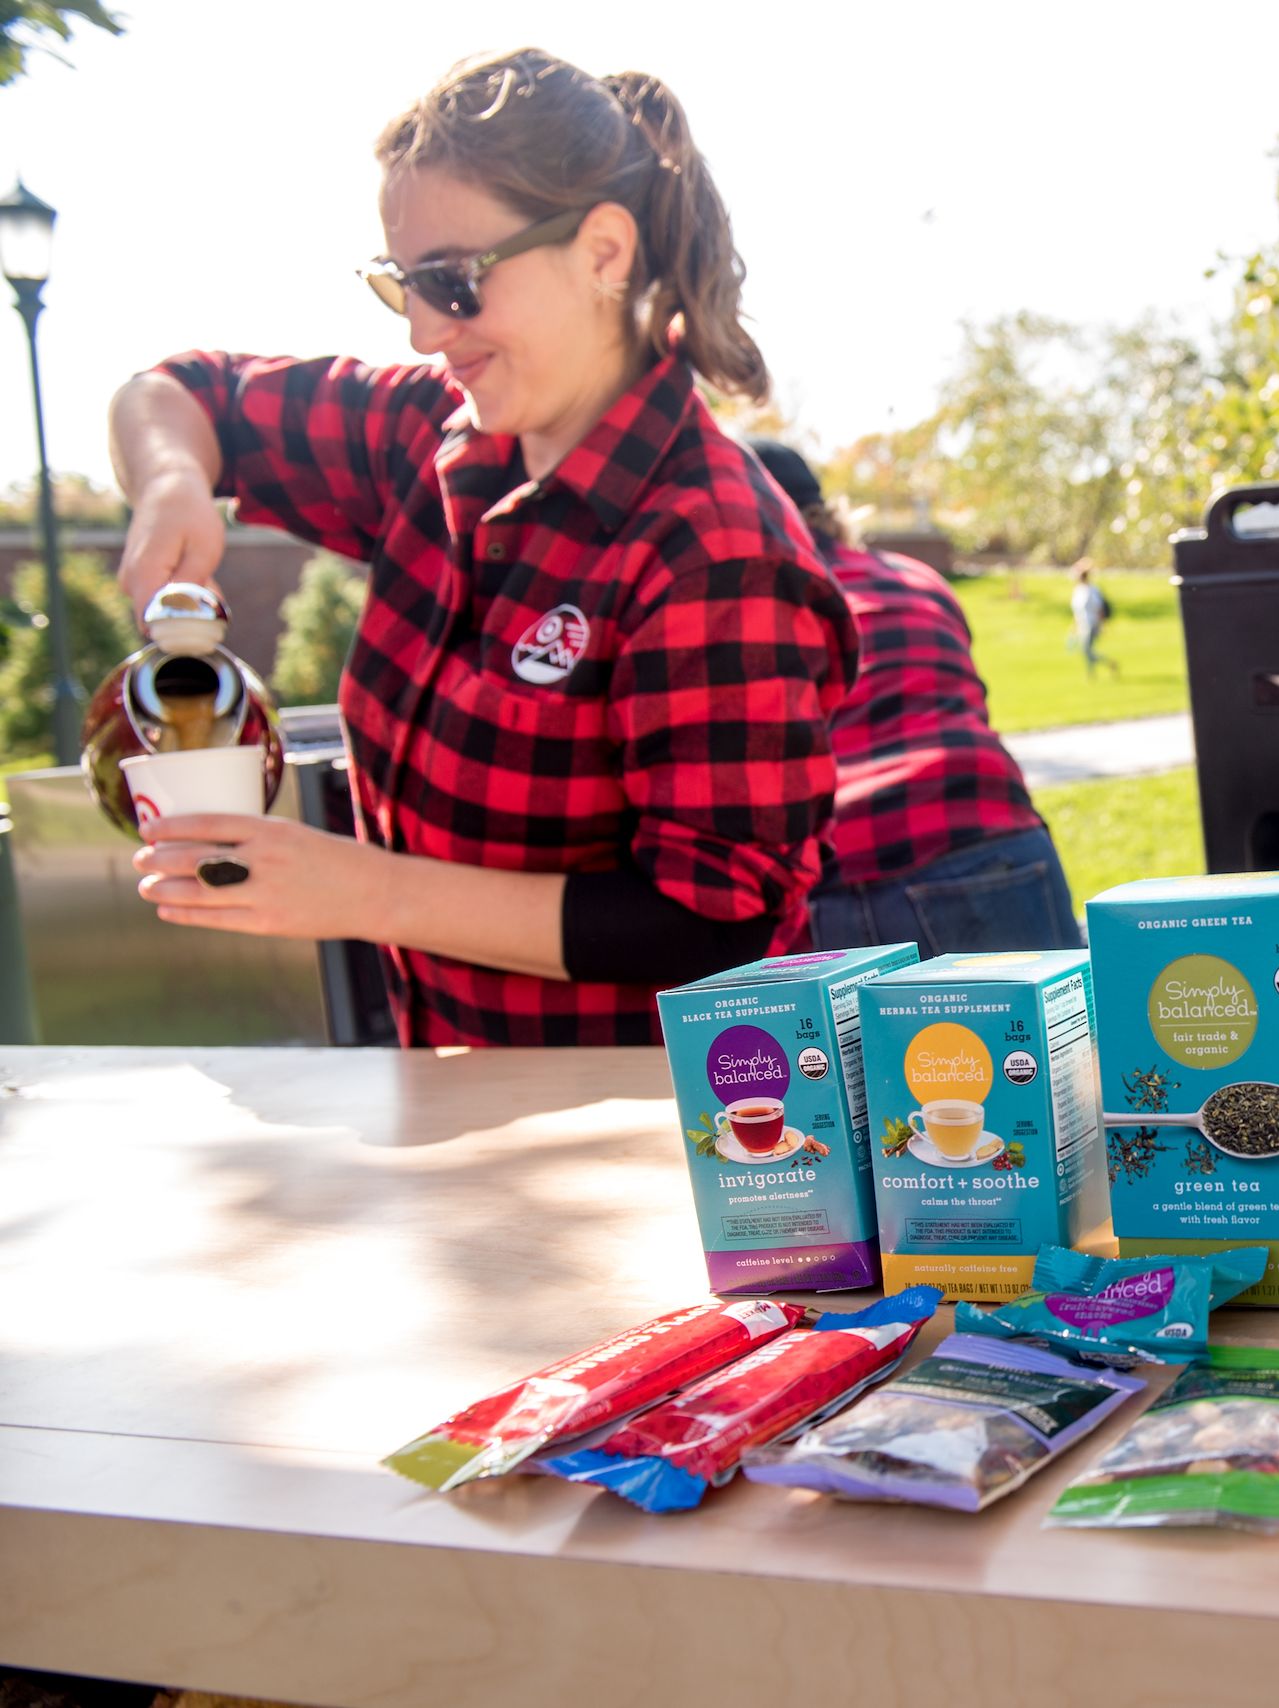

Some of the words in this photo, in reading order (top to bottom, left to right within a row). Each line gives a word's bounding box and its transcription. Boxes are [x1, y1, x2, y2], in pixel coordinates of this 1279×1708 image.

[1138, 918, 1188, 930] ORGANIC
[1191, 917, 1228, 928] GREEN
[1232, 916, 1253, 926] TEA
[1044, 981, 1071, 1004] Supplement
[1069, 978, 1083, 992] Facts
[1165, 976, 1245, 1003] Simply
[715, 997, 759, 1009] ORGANIC
[920, 994, 967, 1003] ORGANIC
[682, 1013, 712, 1023] BLACK
[715, 1010, 732, 1019] TEA
[735, 1003, 796, 1017] SUPPLEMENT
[879, 1007, 918, 1016] HERBAL
[921, 1006, 941, 1014] TEA
[944, 1004, 1011, 1014] SUPPLEMENT
[1158, 999, 1250, 1019] balanced
[800, 1018, 813, 1030] 16
[1010, 1020, 1024, 1032] 16
[796, 1029, 820, 1040] bags
[1005, 1032, 1031, 1043] bags
[1173, 1031, 1194, 1042] fair
[1197, 1031, 1227, 1042] trade
[1230, 1030, 1239, 1041] &
[1185, 1044, 1229, 1056] organic
[718, 1049, 777, 1073] Simply
[803, 1054, 822, 1063] USDA
[917, 1049, 980, 1073] Simply
[1010, 1058, 1030, 1067] USDA
[714, 1066, 784, 1086] balanced
[911, 1067, 985, 1083] balanced
[718, 1168, 817, 1189] invigorate
[882, 1173, 954, 1189] comfort
[958, 1178, 968, 1188] +
[972, 1172, 1040, 1189] soothe
[1174, 1180, 1225, 1195] green
[1232, 1180, 1260, 1192] tea
[728, 1194, 767, 1205] promotes
[921, 1197, 948, 1206] calms
[951, 1197, 966, 1206] the
[1162, 1201, 1192, 1213] gentle
[1194, 1201, 1223, 1211] blend
[1225, 1201, 1236, 1211] of
[1238, 1203, 1268, 1213] green
[1180, 1215, 1201, 1225] with
[1203, 1215, 1228, 1225] fresh
[1231, 1215, 1260, 1225] flavor
[736, 1257, 770, 1267] caffeine
[772, 1256, 794, 1265] level
[914, 1264, 956, 1273] naturally
[959, 1264, 997, 1273] caffeine
[999, 1264, 1018, 1273] free
[948, 1283, 959, 1293] TEA
[959, 1283, 974, 1294] BAGS
[979, 1283, 989, 1294] NET
[990, 1283, 998, 1294] WT
[999, 1283, 1011, 1294] 1.13
[1011, 1284, 1020, 1294] OZ
[1262, 1285, 1275, 1296] 1.27
